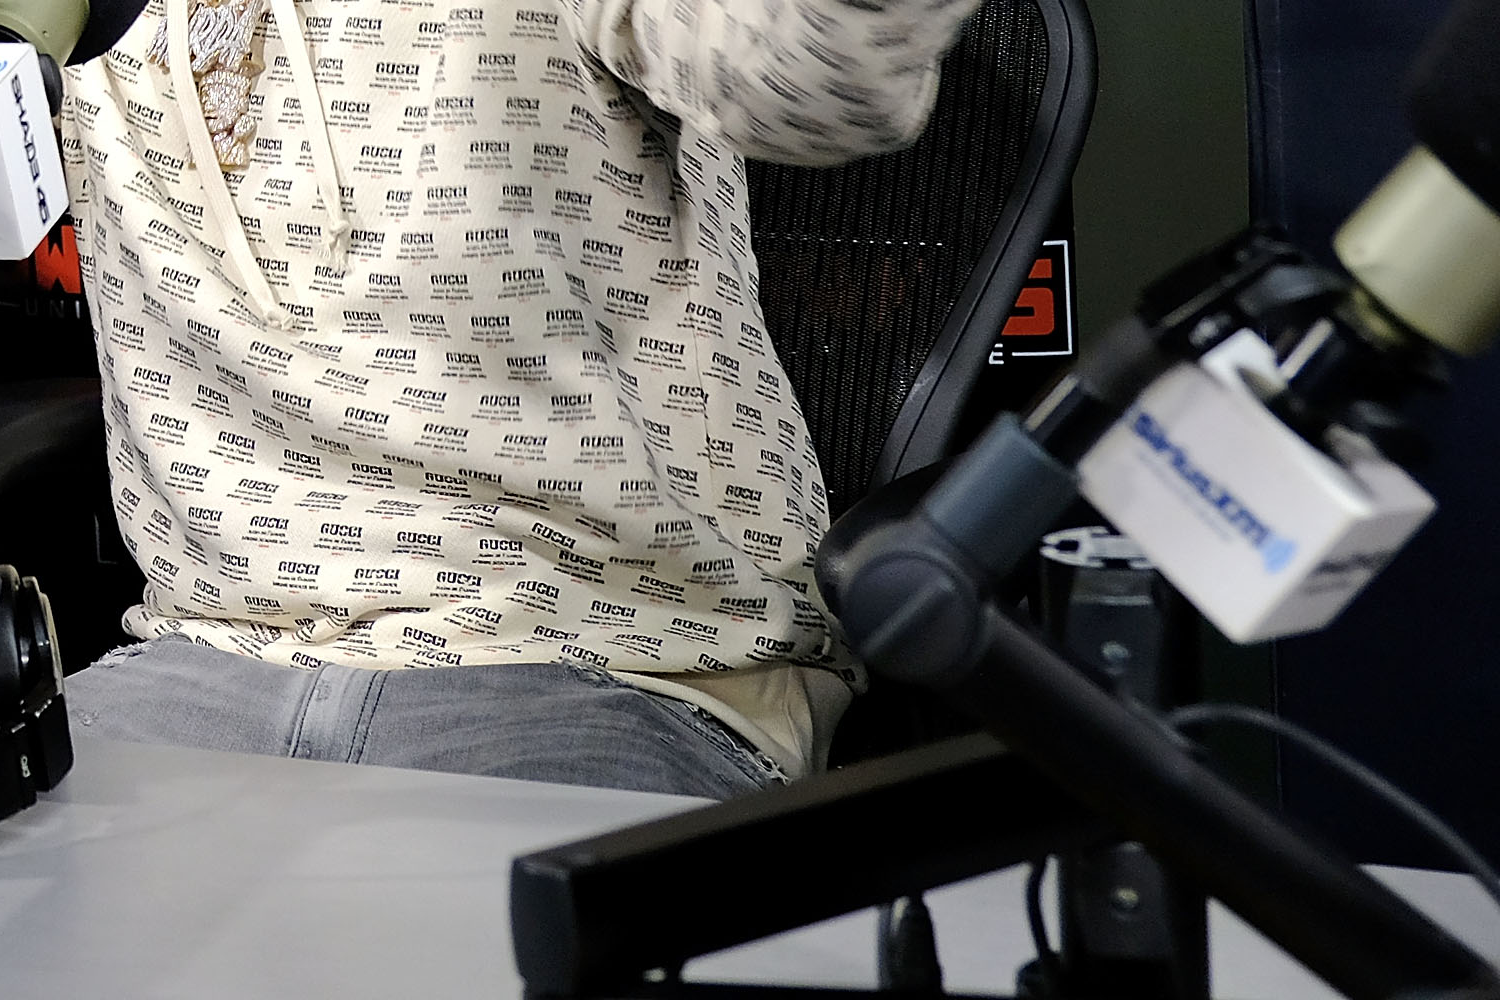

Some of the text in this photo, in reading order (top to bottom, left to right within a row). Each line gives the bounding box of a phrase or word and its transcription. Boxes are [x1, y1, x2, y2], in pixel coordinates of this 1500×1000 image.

[11, 74, 41, 182] SHADE
[532, 522, 576, 549] GUCCI
[152, 555, 180, 577] GUCCI
